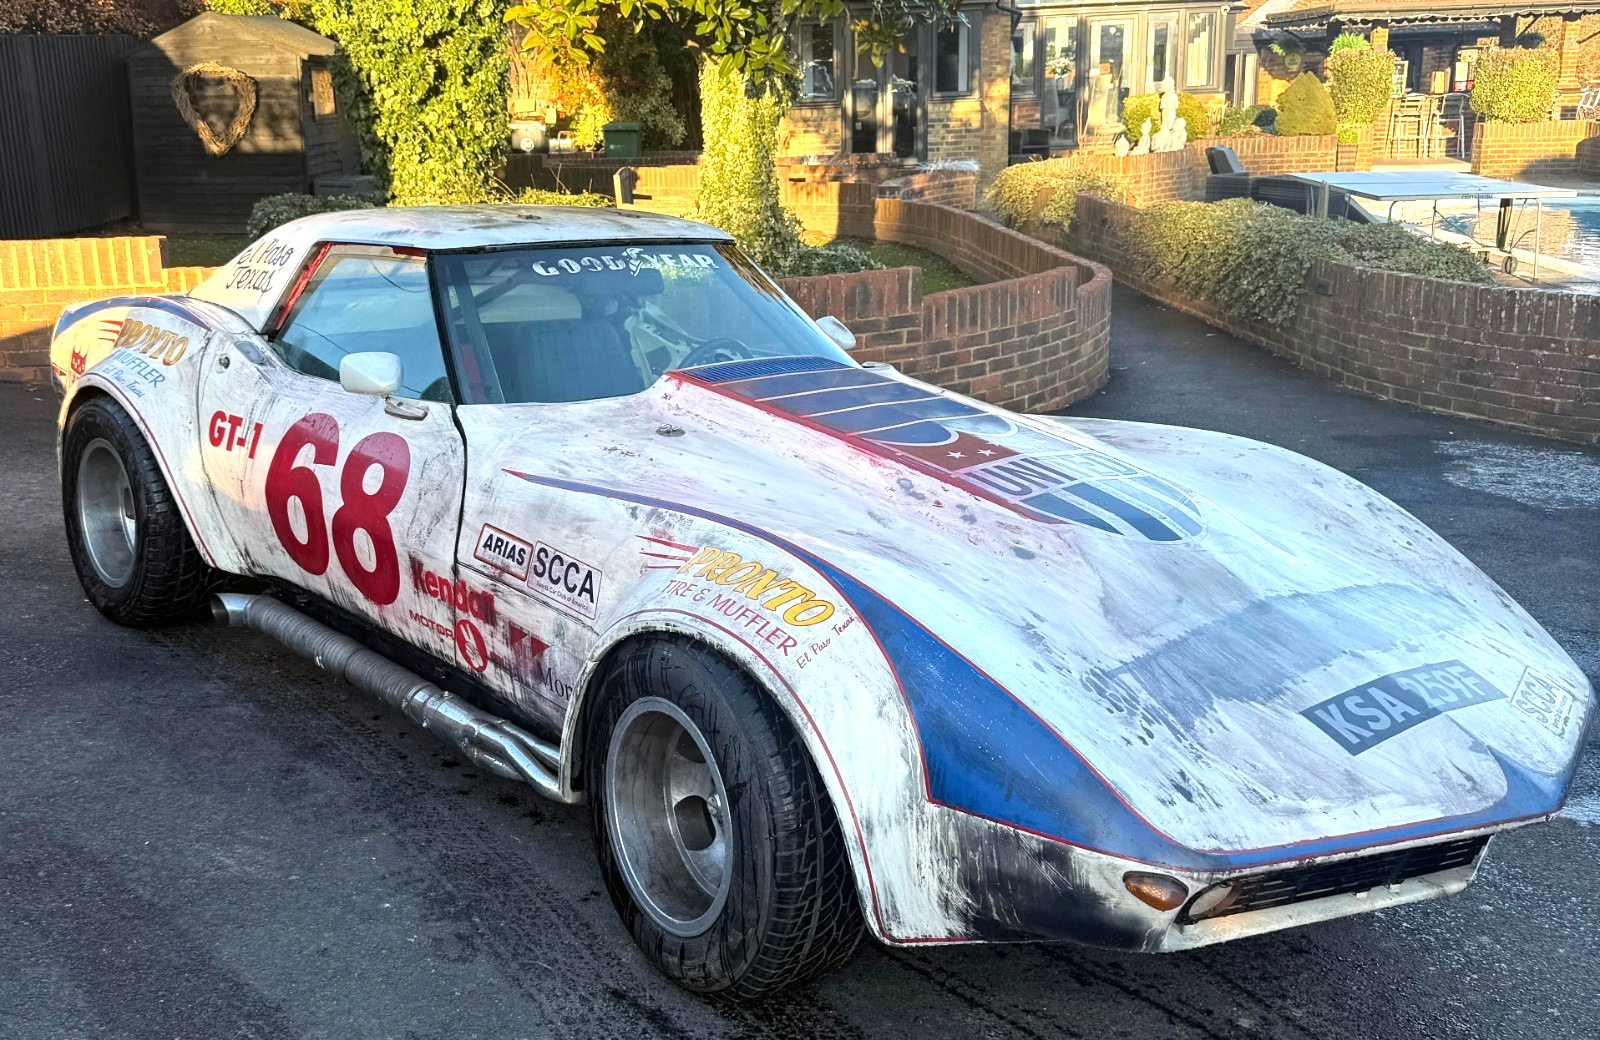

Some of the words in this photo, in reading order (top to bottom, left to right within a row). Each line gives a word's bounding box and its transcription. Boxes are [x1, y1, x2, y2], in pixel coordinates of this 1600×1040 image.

[237, 241, 267, 265] El
[256, 238, 294, 267] Paso
[226, 264, 276, 294] Texas
[114, 318, 189, 367] PRONTO
[112, 349, 166, 389] MUFFLER
[209, 410, 264, 460] GT-1
[964, 452, 1138, 496] UNITED
[265, 412, 411, 606] 68
[482, 533, 527, 566] ARIAS
[533, 547, 595, 604] SCCA
[677, 545, 835, 627] PRONTO
[409, 609, 455, 640] MOTOR
[660, 579, 698, 598] TIRE
[693, 588, 711, 602] &
[706, 593, 798, 657] MUFFLER
[796, 652, 812, 670] El
[809, 637, 831, 655] Paso
[831, 616, 855, 636] Texas
[1314, 686, 1421, 745] KSA
[1395, 665, 1486, 709] 259F
[1516, 671, 1561, 724] SCCA
